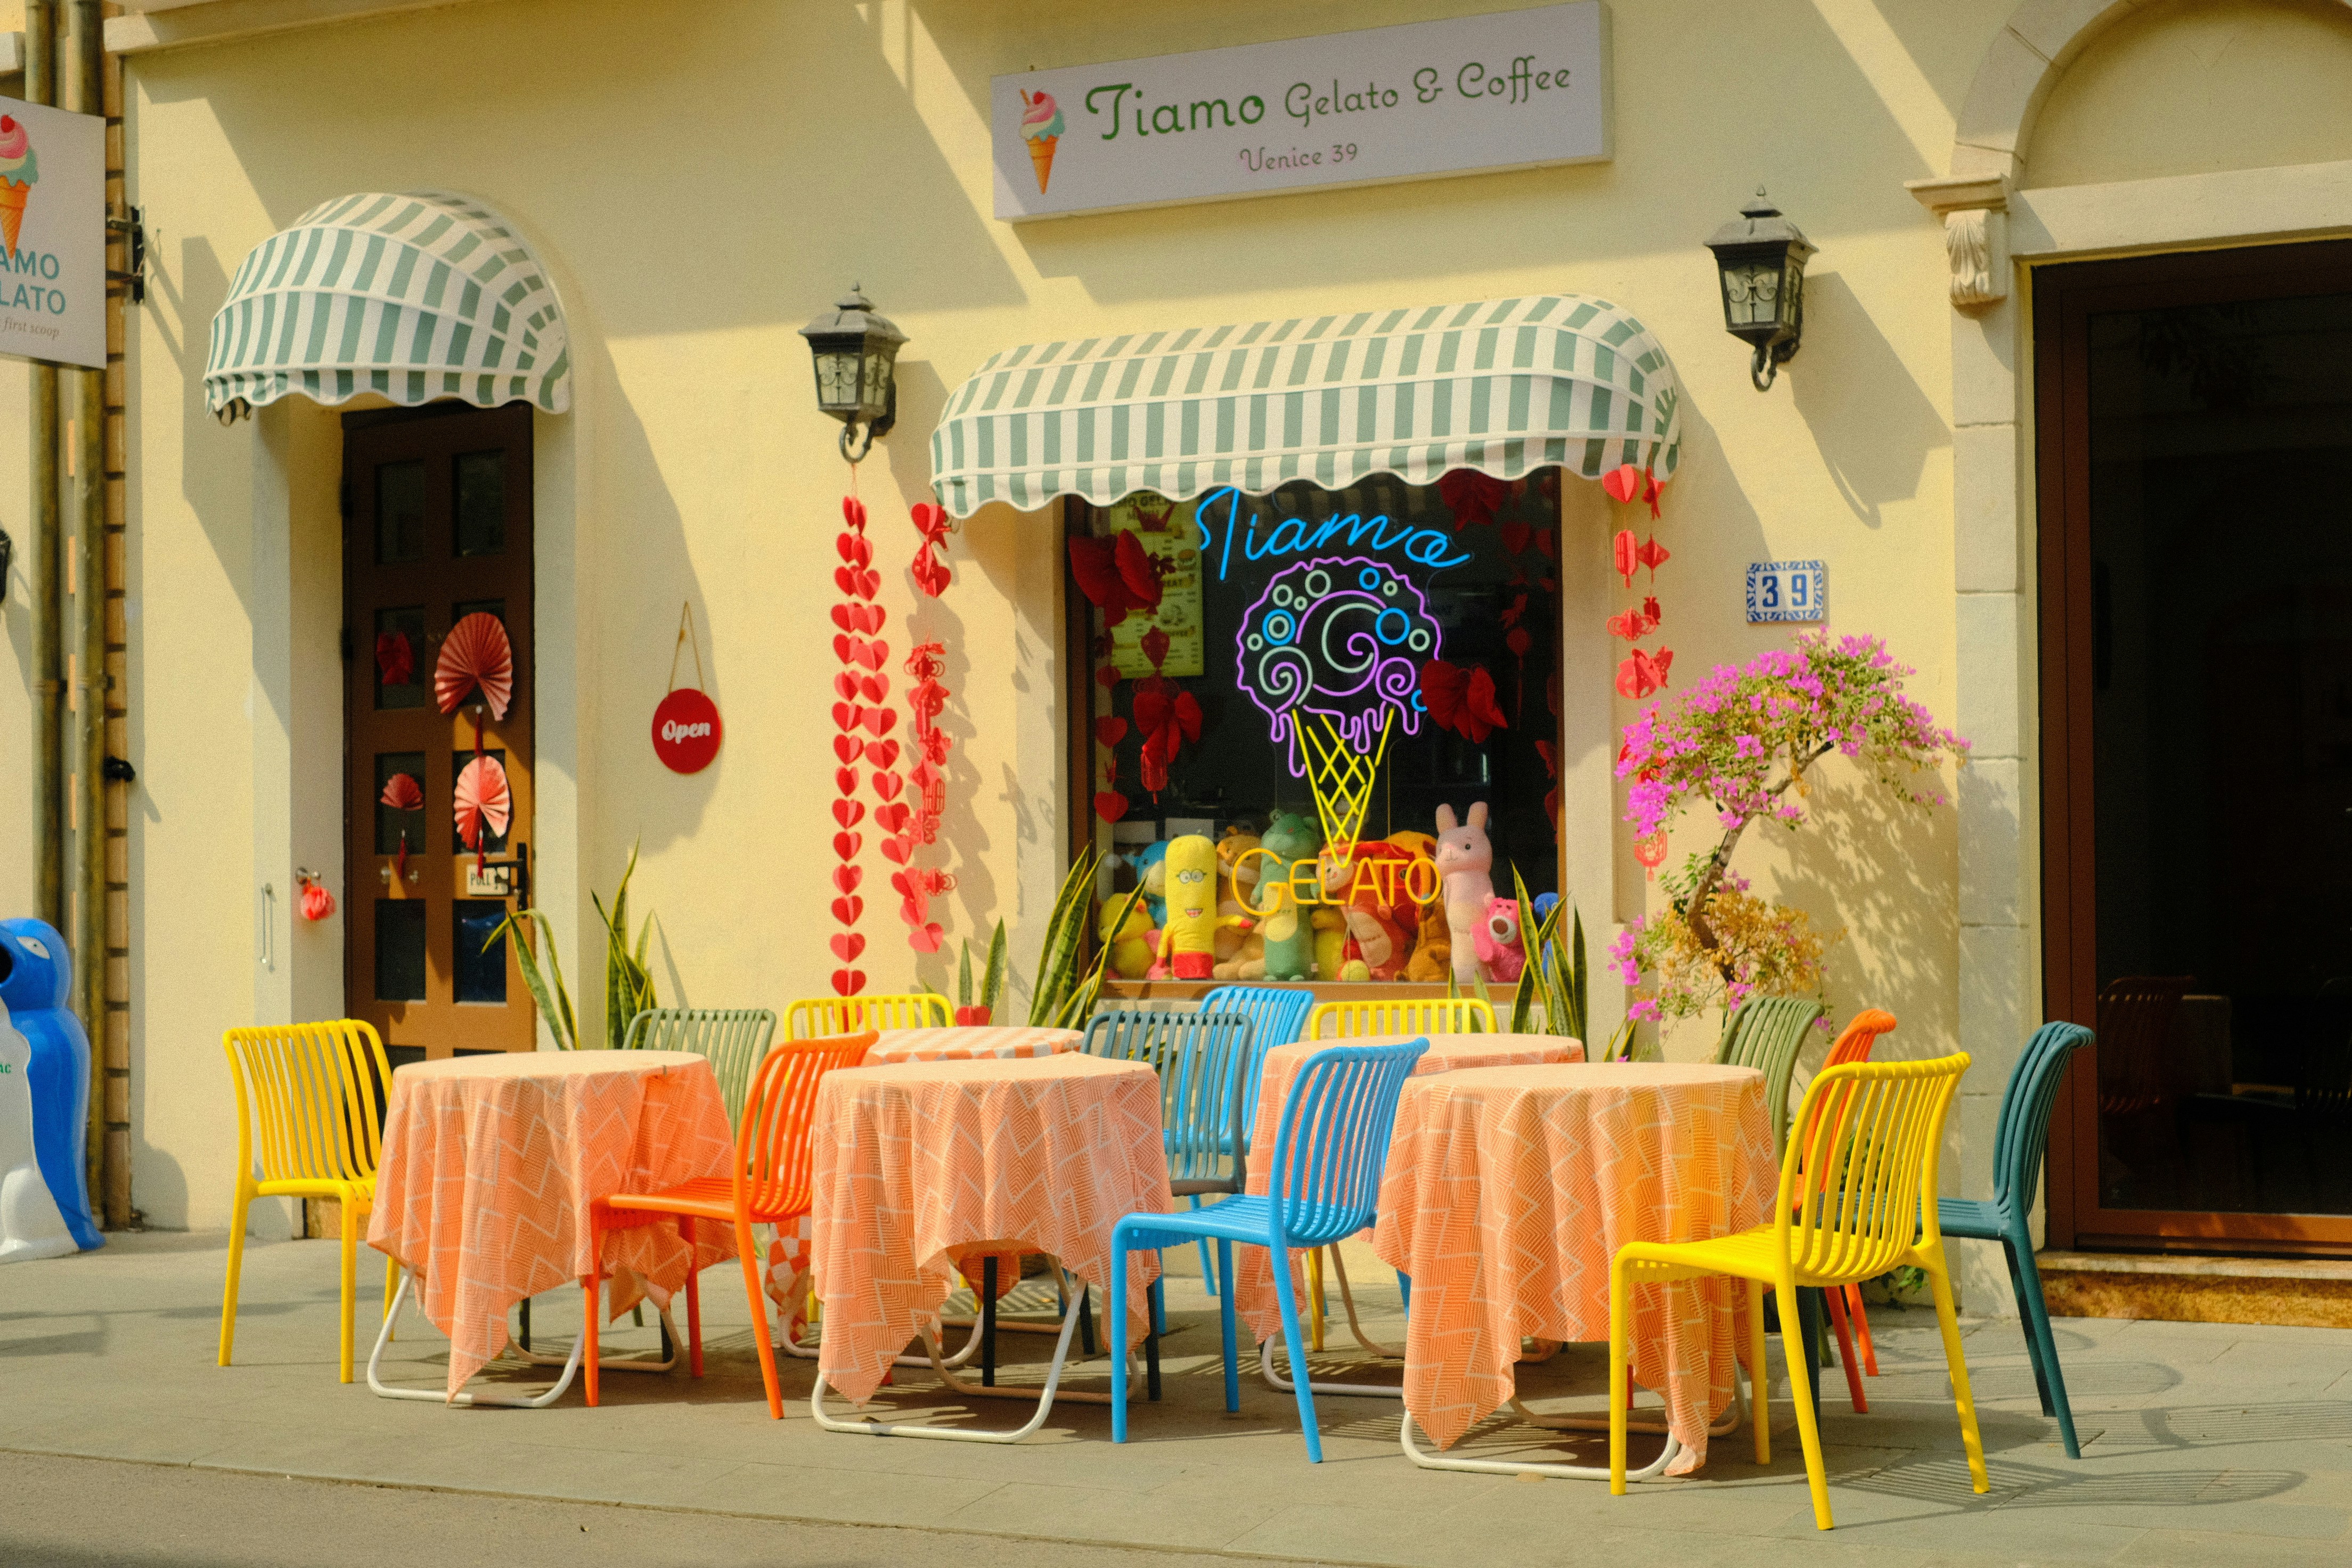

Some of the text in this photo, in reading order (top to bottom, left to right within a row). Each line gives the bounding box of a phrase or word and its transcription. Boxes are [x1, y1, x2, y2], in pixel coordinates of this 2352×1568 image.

[1085, 55, 1571, 140] Tiamo Gelato & Coffee
[1239, 143, 1358, 172] Venice 39
[3, 316, 60, 341] first scoop
[1195, 486, 1471, 581] Tiamo
[1762, 574, 1808, 608] 39
[661, 719, 710, 745] Open
[1231, 847, 1442, 916] GELATO
